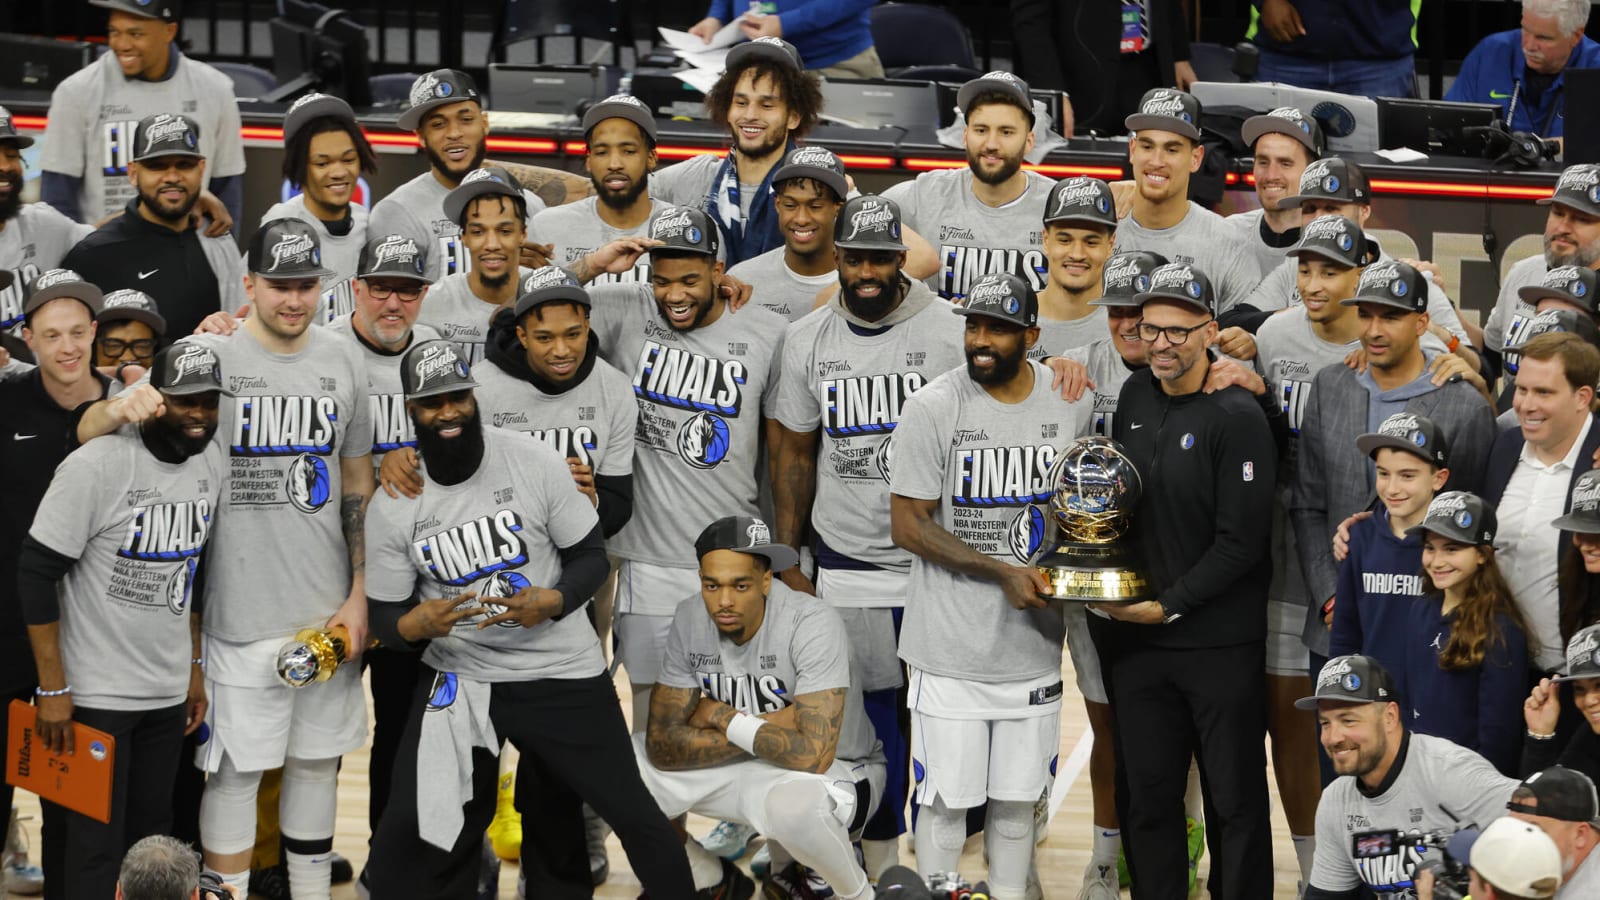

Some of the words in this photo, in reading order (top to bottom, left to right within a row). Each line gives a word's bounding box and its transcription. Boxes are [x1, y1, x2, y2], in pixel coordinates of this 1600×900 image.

[1142, 95, 1185, 115] Finals
[143, 116, 188, 154] Finals
[791, 149, 836, 166] Finals
[862, 200, 878, 211] NBA
[1054, 181, 1101, 217] Finals
[651, 211, 693, 241] Finals
[846, 204, 894, 241] Finals
[874, 221, 889, 233] 2024
[946, 226, 975, 241] Finals
[1319, 229, 1337, 240] 2024
[267, 233, 315, 273] Finals
[370, 239, 418, 273] Finals
[37, 269, 81, 291] Finals
[524, 266, 567, 293] Finals
[1102, 259, 1142, 297] Finals
[1149, 265, 1195, 294] Finals
[103, 290, 149, 309] Finals
[966, 280, 1013, 310] Finals
[450, 323, 481, 340] Finals
[1027, 345, 1048, 359] nals
[171, 348, 217, 386] Finals
[415, 347, 458, 393] Finals
[825, 360, 852, 376] Finals
[1285, 361, 1310, 376] Finals
[235, 376, 269, 394] Finals
[632, 338, 748, 419] FINALS
[230, 395, 338, 457] FINALS
[498, 412, 529, 429] Finals
[956, 428, 989, 448] Finals
[231, 469, 248, 479] NBA
[249, 469, 284, 480] WESTERN
[834, 465, 868, 477] AMPIONS
[952, 443, 1058, 509] FINALS
[231, 480, 280, 491] CONFERENCE
[231, 492, 278, 502] CHAMPIONS
[953, 507, 984, 519] 2023-24
[117, 498, 210, 562] FINALS
[953, 518, 969, 529] NBA
[970, 519, 1007, 530] WESTERN
[953, 529, 1003, 541] CONFERENCE
[412, 508, 530, 588] FINALS
[110, 574, 161, 593] CONFERENCE
[131, 568, 167, 582] WESTERN
[1362, 572, 1425, 597] MAVERI
[108, 584, 156, 603] CHAMPIONS
[696, 653, 723, 669] Final
[694, 670, 794, 718] FINALS
[18, 727, 33, 778] Wilson
